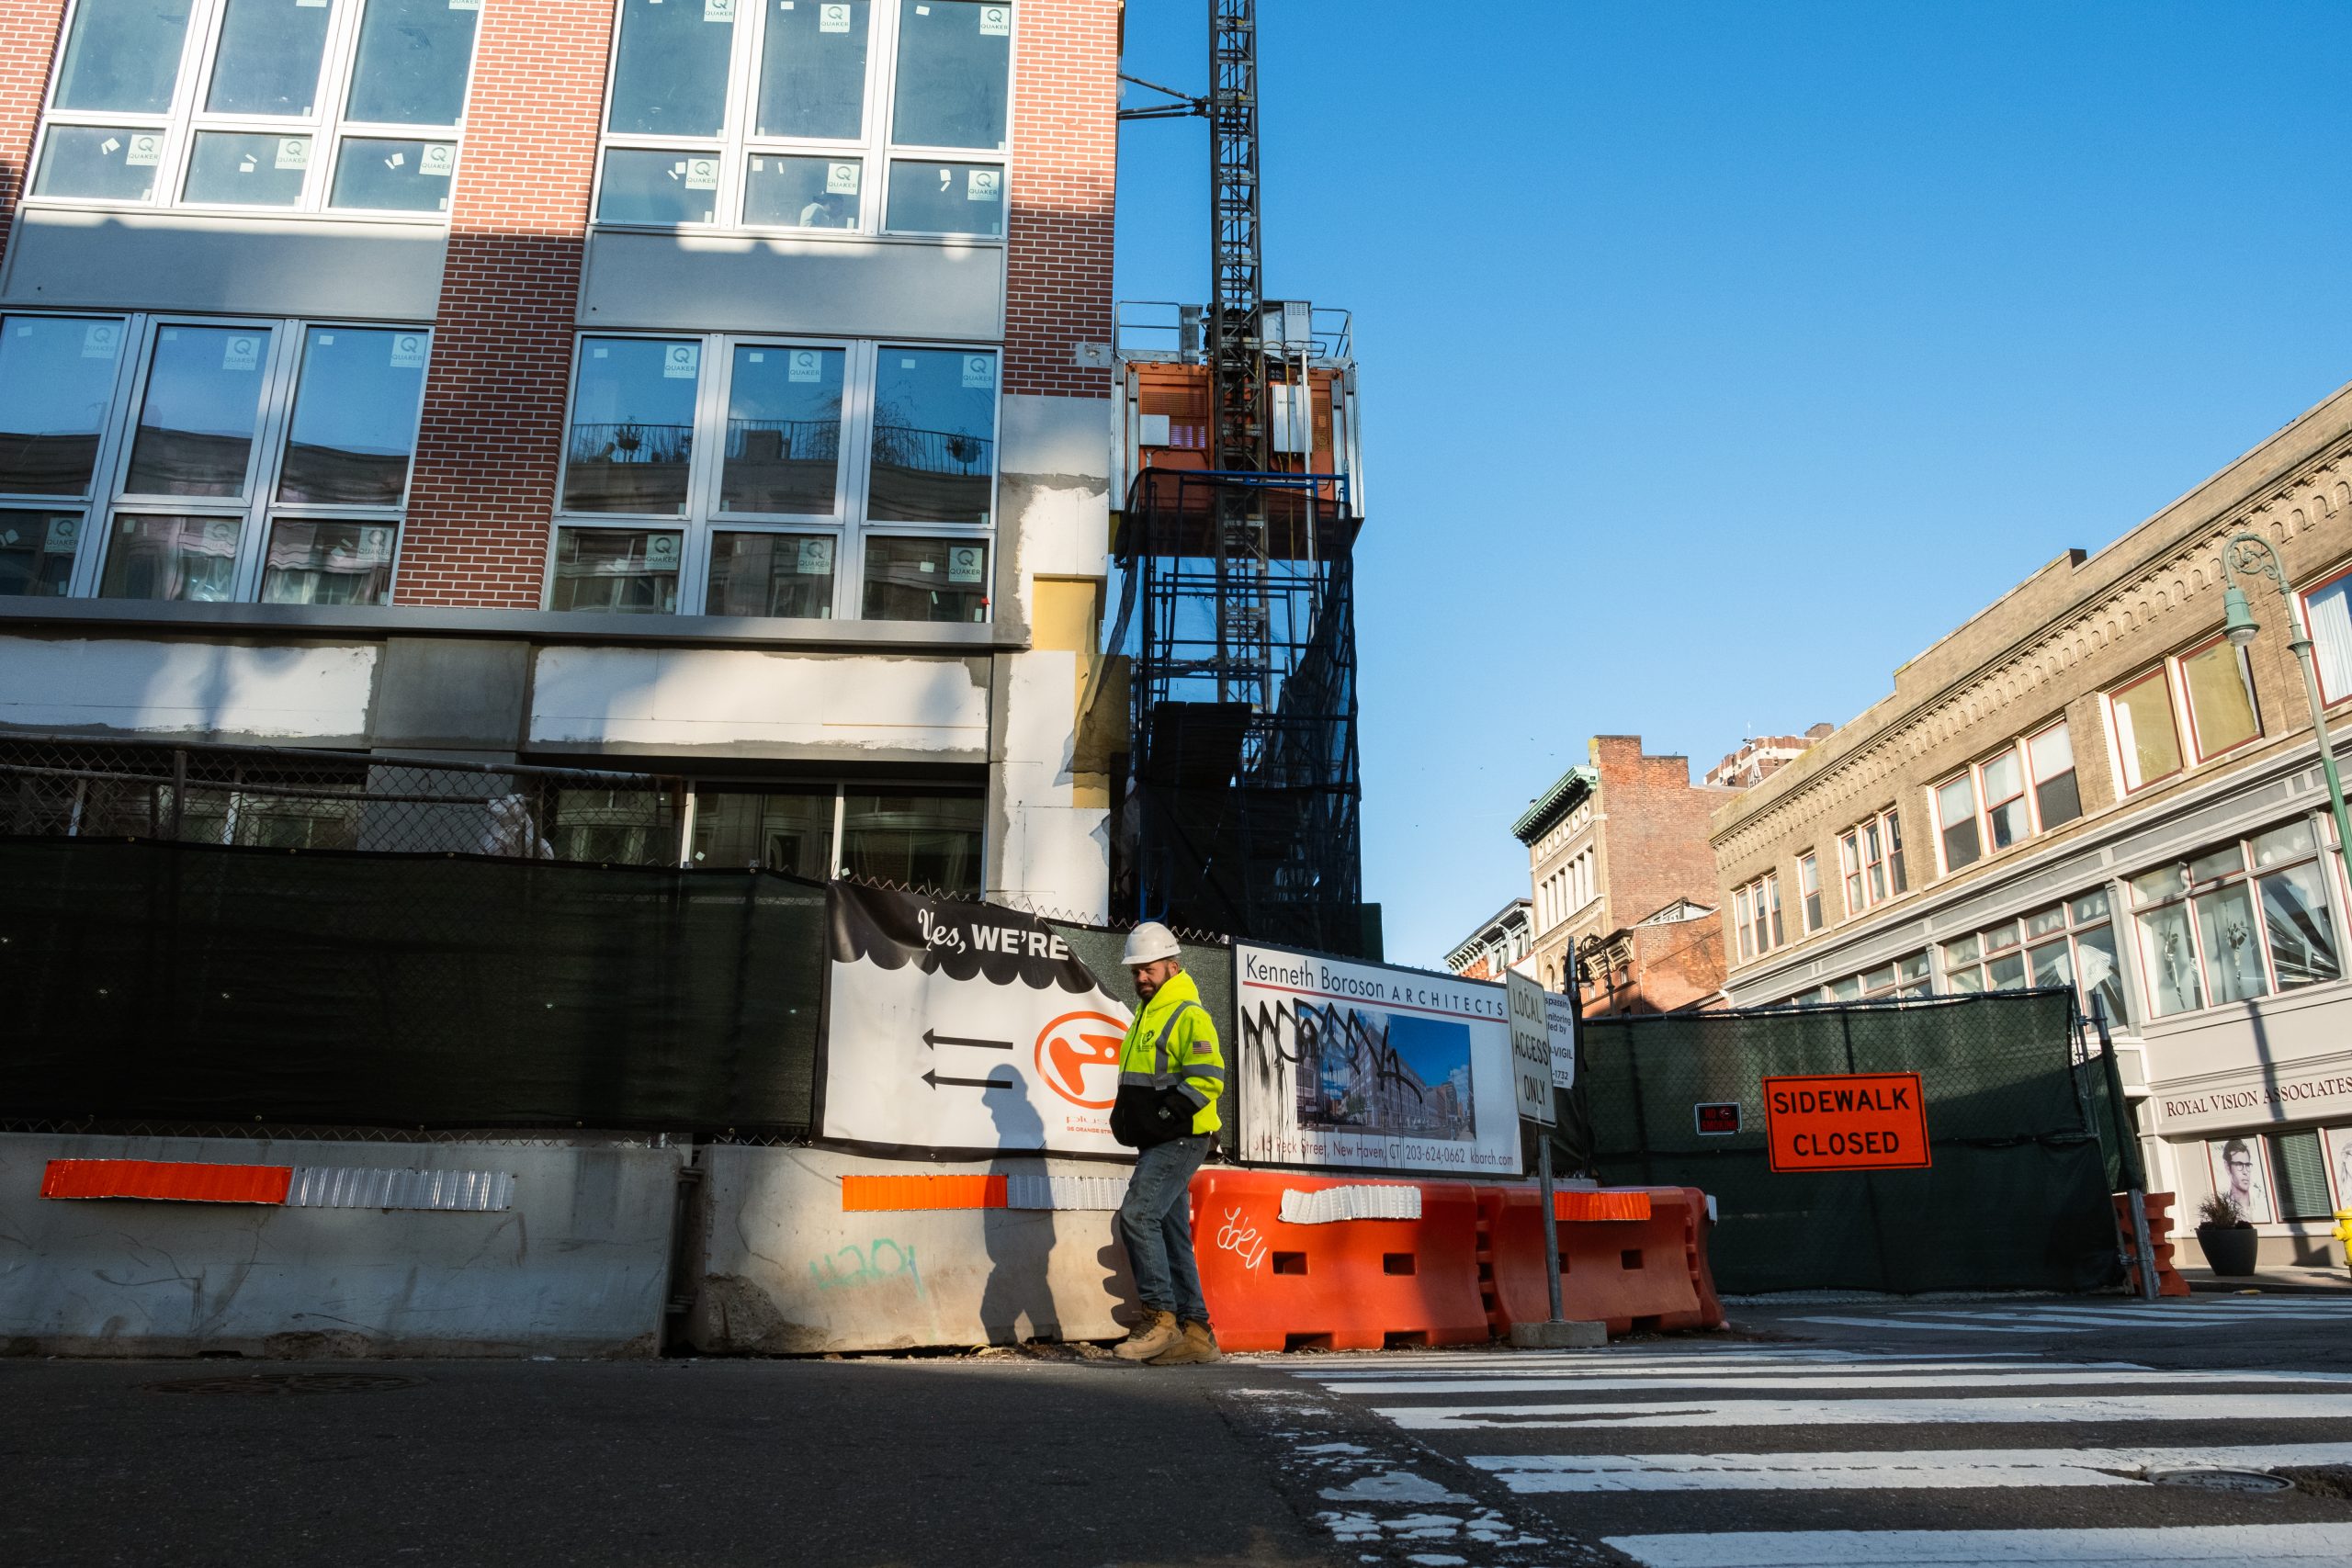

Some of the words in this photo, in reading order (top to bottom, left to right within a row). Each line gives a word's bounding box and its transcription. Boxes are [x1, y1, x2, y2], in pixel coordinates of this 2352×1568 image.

[918, 908, 966, 954] Yes,
[971, 923, 1069, 961] WE'RE
[1247, 953, 1314, 987] Kenneth
[1321, 966, 1385, 998] Boroson
[1391, 985, 1504, 1016] ARCHITECTS
[1513, 987, 1543, 1024] LOCAL
[1559, 1023, 1567, 1034] by
[1515, 1030, 1549, 1066] ACCESS
[1550, 1046, 1573, 1060] -VIGIL
[1552, 1069, 1569, 1080] -1732
[1523, 1074, 1545, 1105] ONLY
[1774, 1088, 1910, 1114] SIDEWALK
[2165, 1098, 2209, 1117] ROYAL
[2210, 1090, 2259, 1111] VISION
[2263, 1077, 2352, 1104] ASSOCIATES
[1702, 1120, 1737, 1131] SMOKING
[1705, 1108, 1715, 1119] NO
[1275, 1138, 1298, 1154] Peck
[1301, 1139, 1330, 1158] Street,
[1333, 1142, 1353, 1156] New
[1356, 1143, 1387, 1160] Haven,
[1389, 1144, 1401, 1159] CT
[1406, 1145, 1466, 1165] 203-624-0662
[1470, 1148, 1514, 1168] kbarch.com
[1793, 1131, 1900, 1156] CLOSED
